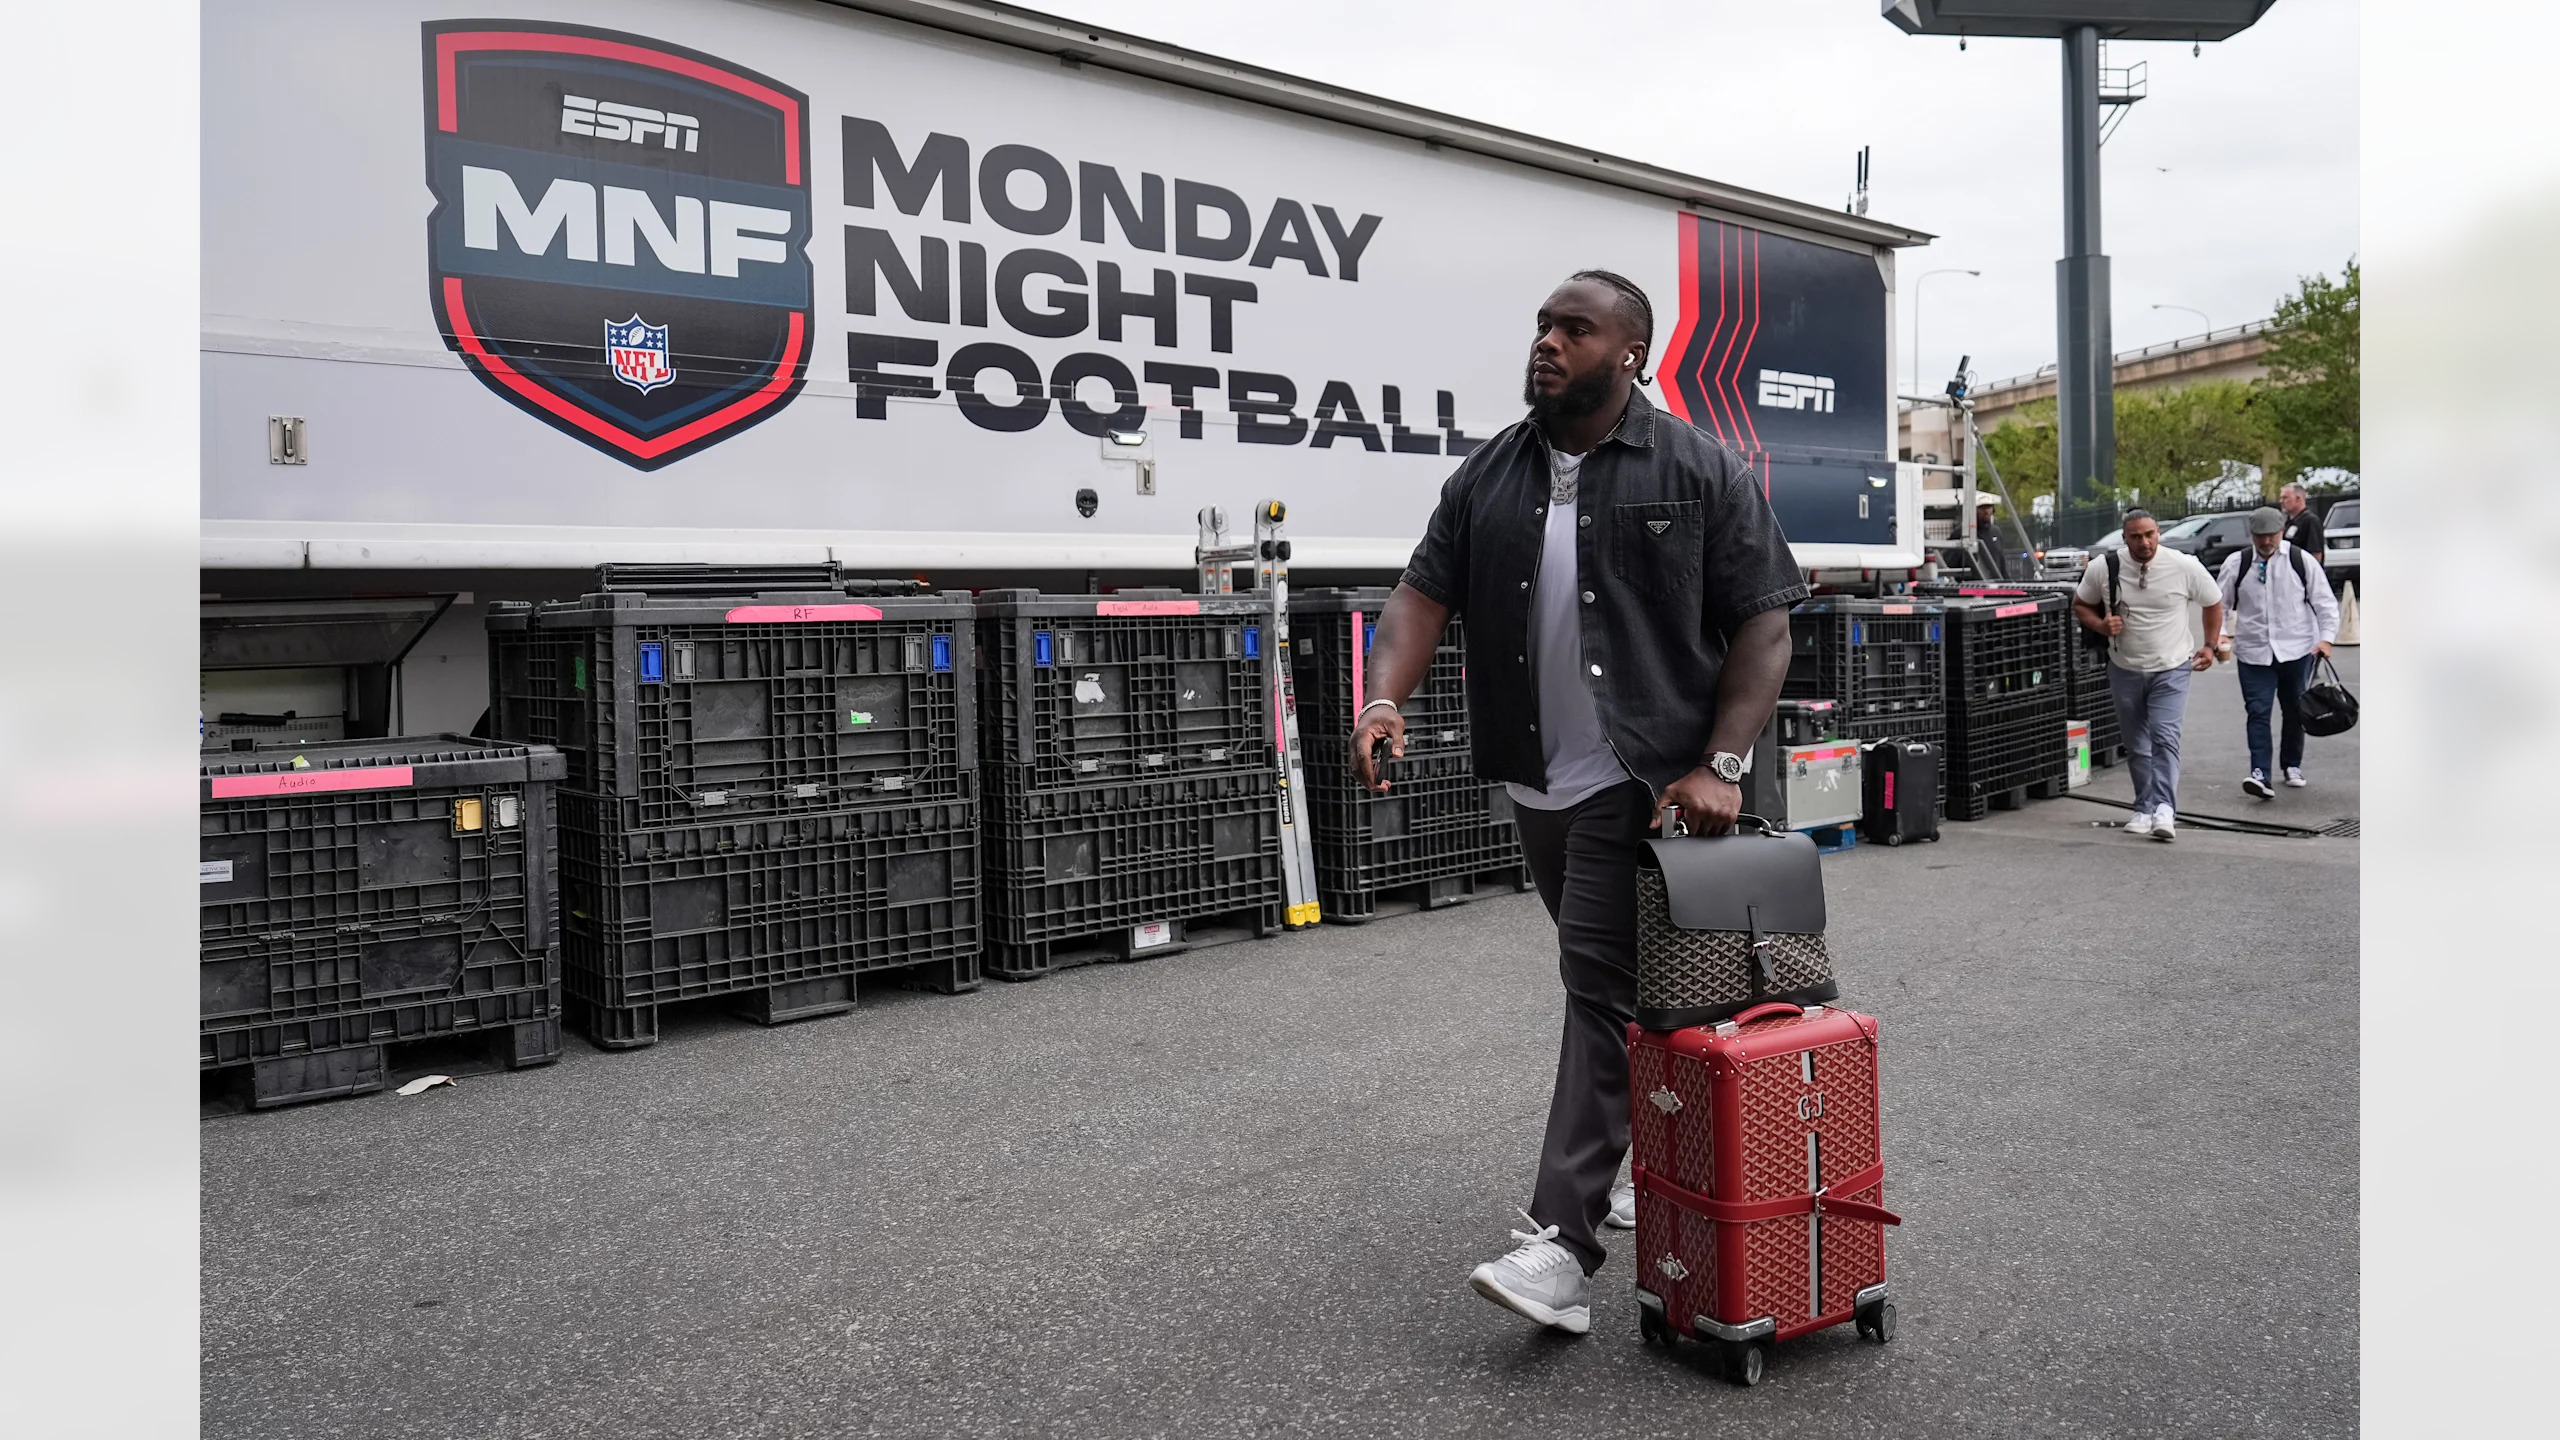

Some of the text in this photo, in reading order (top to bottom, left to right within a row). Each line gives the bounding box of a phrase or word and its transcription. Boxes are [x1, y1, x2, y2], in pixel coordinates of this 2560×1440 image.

[561, 94, 701, 153] ESPN
[462, 165, 794, 279] MNF
[841, 114, 1383, 283] MONDAY
[844, 224, 1258, 354] NIGHT
[614, 349, 669, 382] NFL
[847, 331, 1492, 457] FOOTBALL
[1758, 368, 1835, 413] ESPN
[793, 608, 815, 620] RF
[278, 776, 316, 789] Audio
[1277, 751, 1291, 824] GORILLA LADDE
[1798, 1092, 1825, 1120] GJ
